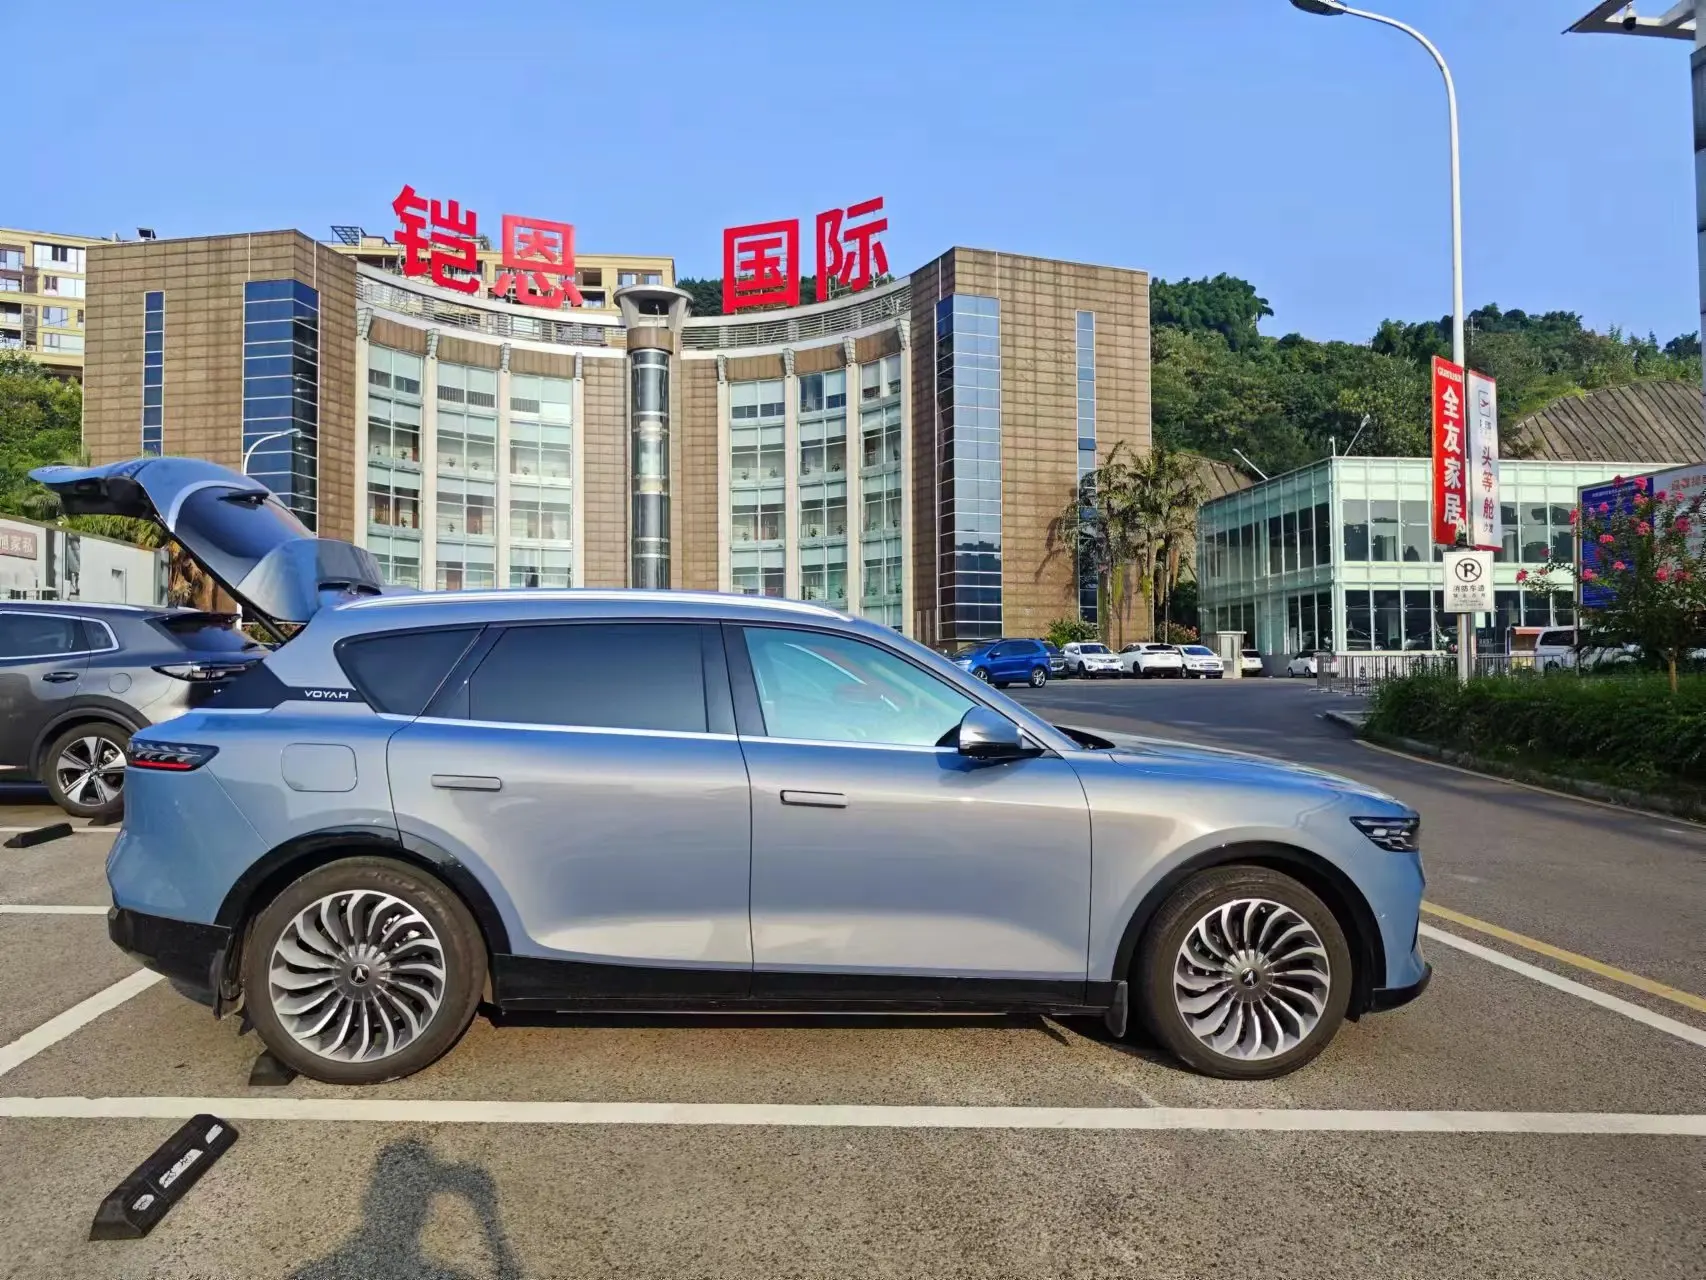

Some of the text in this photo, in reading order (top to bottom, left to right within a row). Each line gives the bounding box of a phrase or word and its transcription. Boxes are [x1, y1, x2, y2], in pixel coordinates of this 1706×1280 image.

[1441, 385, 1463, 525] 全友家居
[1481, 445, 1495, 520] 头等舱
[304, 690, 350, 699] VOYAH
